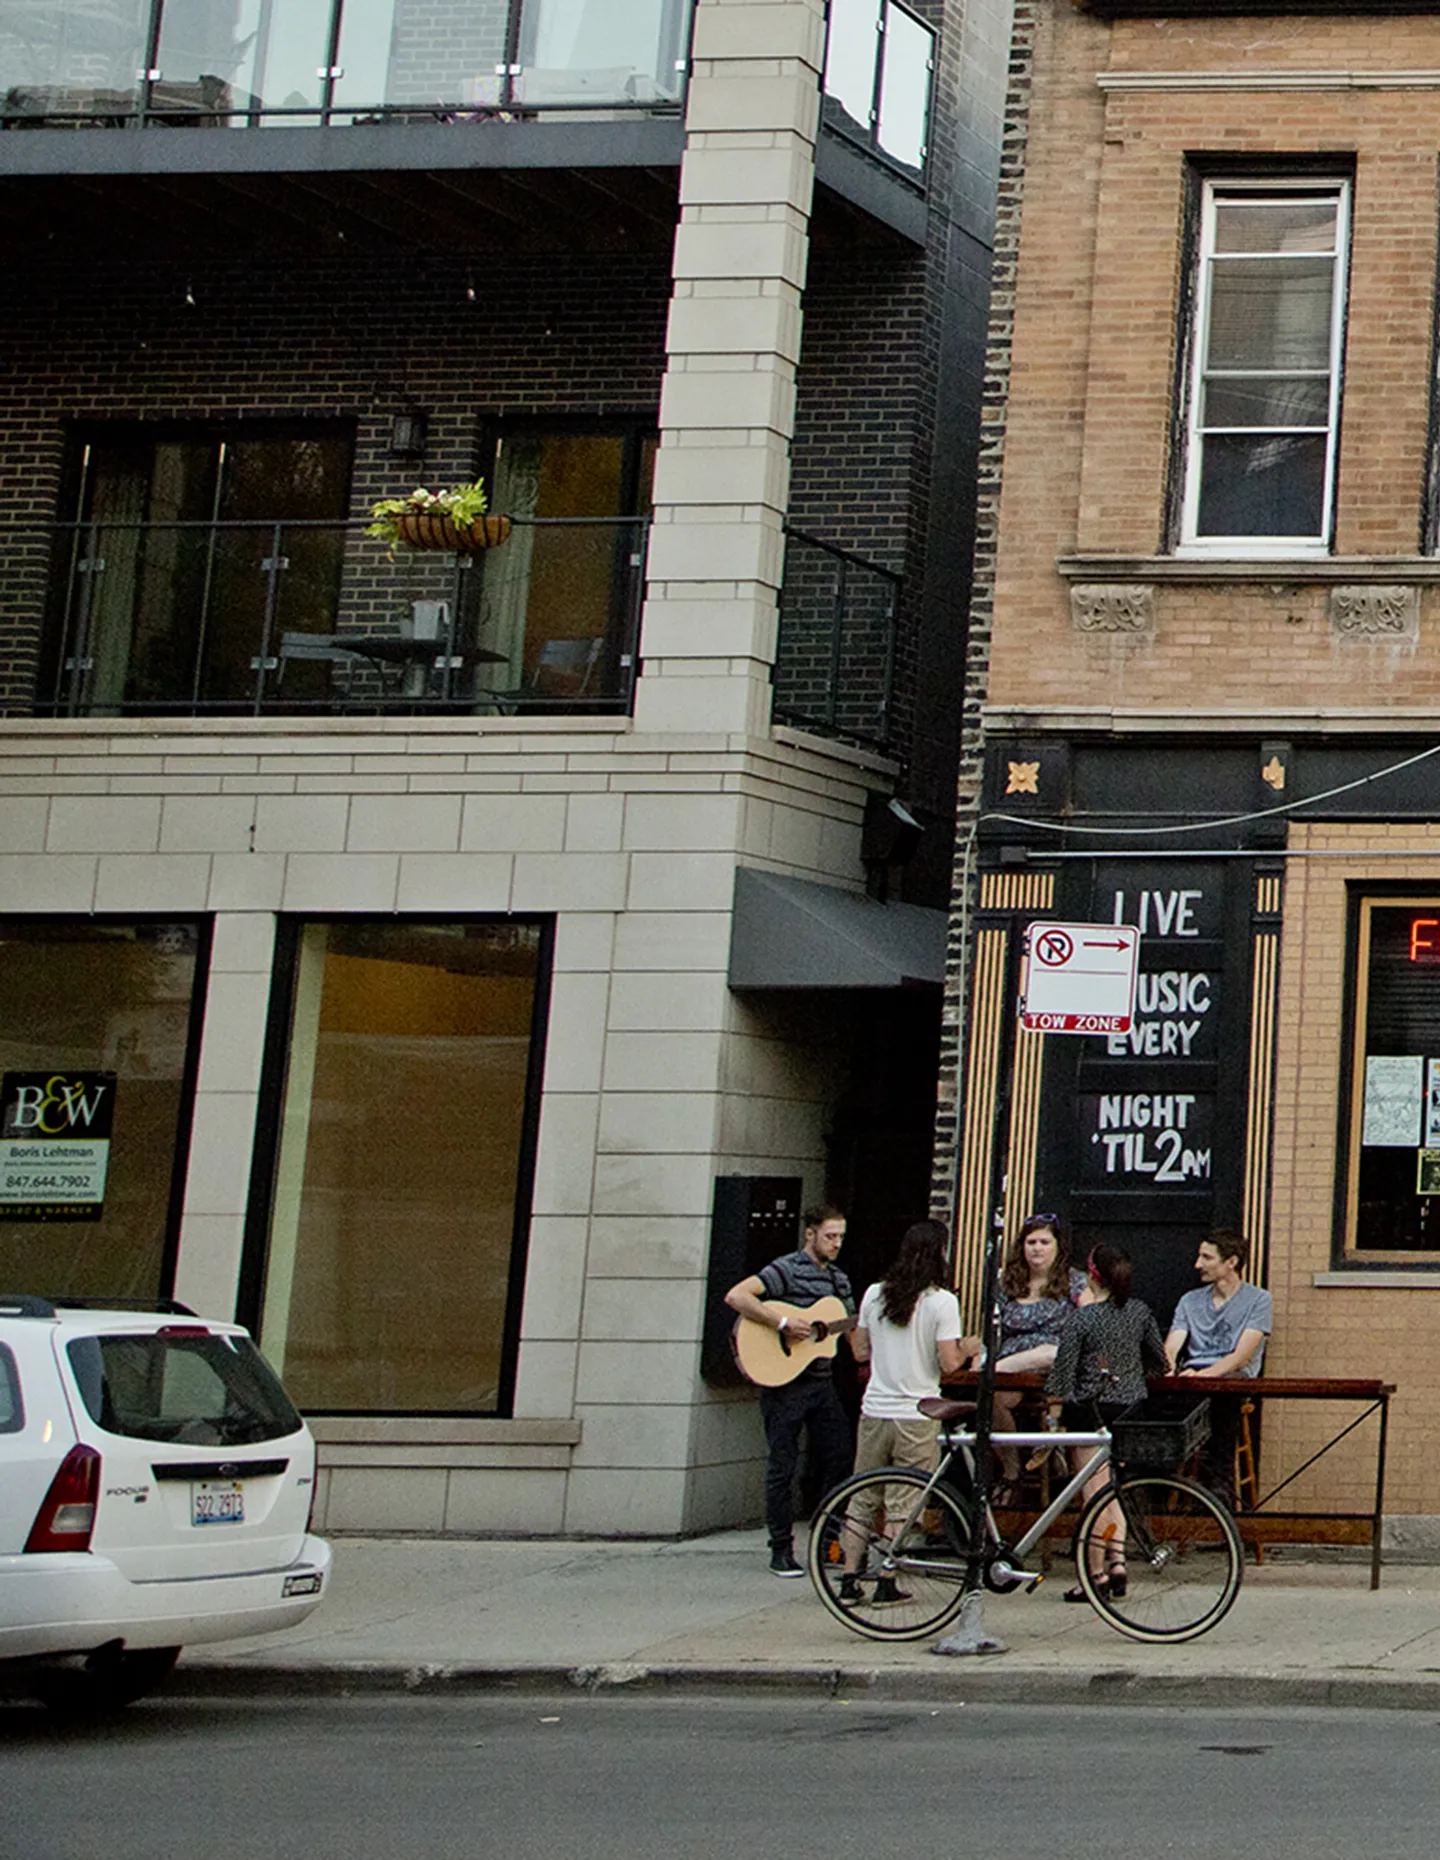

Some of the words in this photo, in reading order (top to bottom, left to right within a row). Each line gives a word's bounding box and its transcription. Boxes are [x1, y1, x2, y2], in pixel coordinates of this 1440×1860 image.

[1113, 890, 1203, 936] LIVE
[1138, 971, 1212, 1014] USIC
[1029, 1013, 1067, 1030] TOW
[1074, 1015, 1122, 1031] ZONE
[1107, 1020, 1201, 1056] EVERY
[10, 1075, 107, 1133] B&W
[1099, 1094, 1196, 1130] NIGHT
